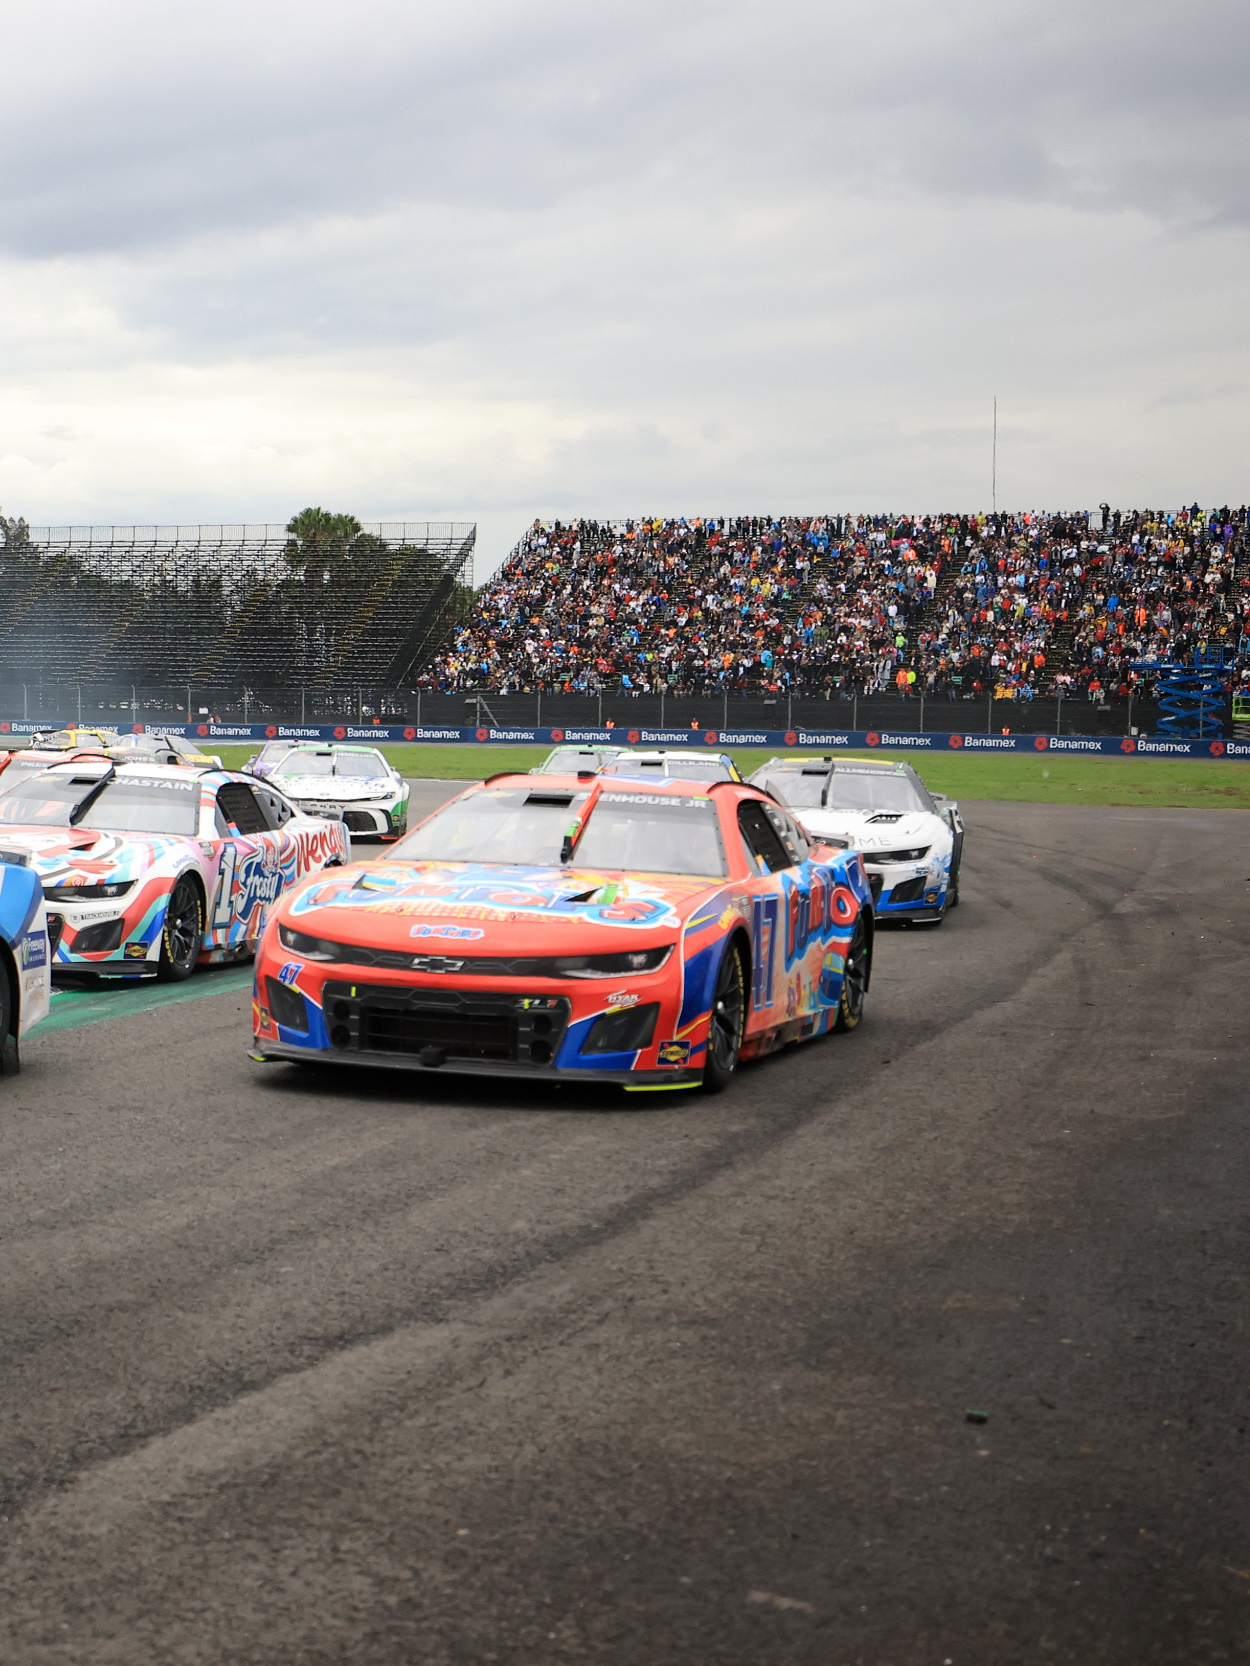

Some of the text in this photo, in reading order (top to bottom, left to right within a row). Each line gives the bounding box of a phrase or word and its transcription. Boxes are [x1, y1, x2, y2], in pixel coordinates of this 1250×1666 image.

[11, 722, 52, 733] Banamex
[144, 724, 186, 735] Banamex
[209, 725, 252, 736] Banamex
[278, 727, 321, 737] Banamex
[347, 727, 390, 738] Banamex
[416, 728, 461, 739] Banamex
[489, 729, 535, 741] Banamex
[564, 730, 611, 741] Banamex
[641, 731, 688, 743] Banamex
[718, 732, 767, 744] Banamex
[798, 733, 849, 745] Banamex
[881, 734, 932, 746] Banamex
[964, 736, 1016, 748] Banamex
[1049, 737, 1102, 750] Banamex
[1137, 740, 1191, 753] Banamex
[106, 777, 194, 791] CHASTAIN
[578, 792, 708, 809] SENHOUSE JR
[212, 842, 237, 929] 1
[277, 962, 304, 986] 47
